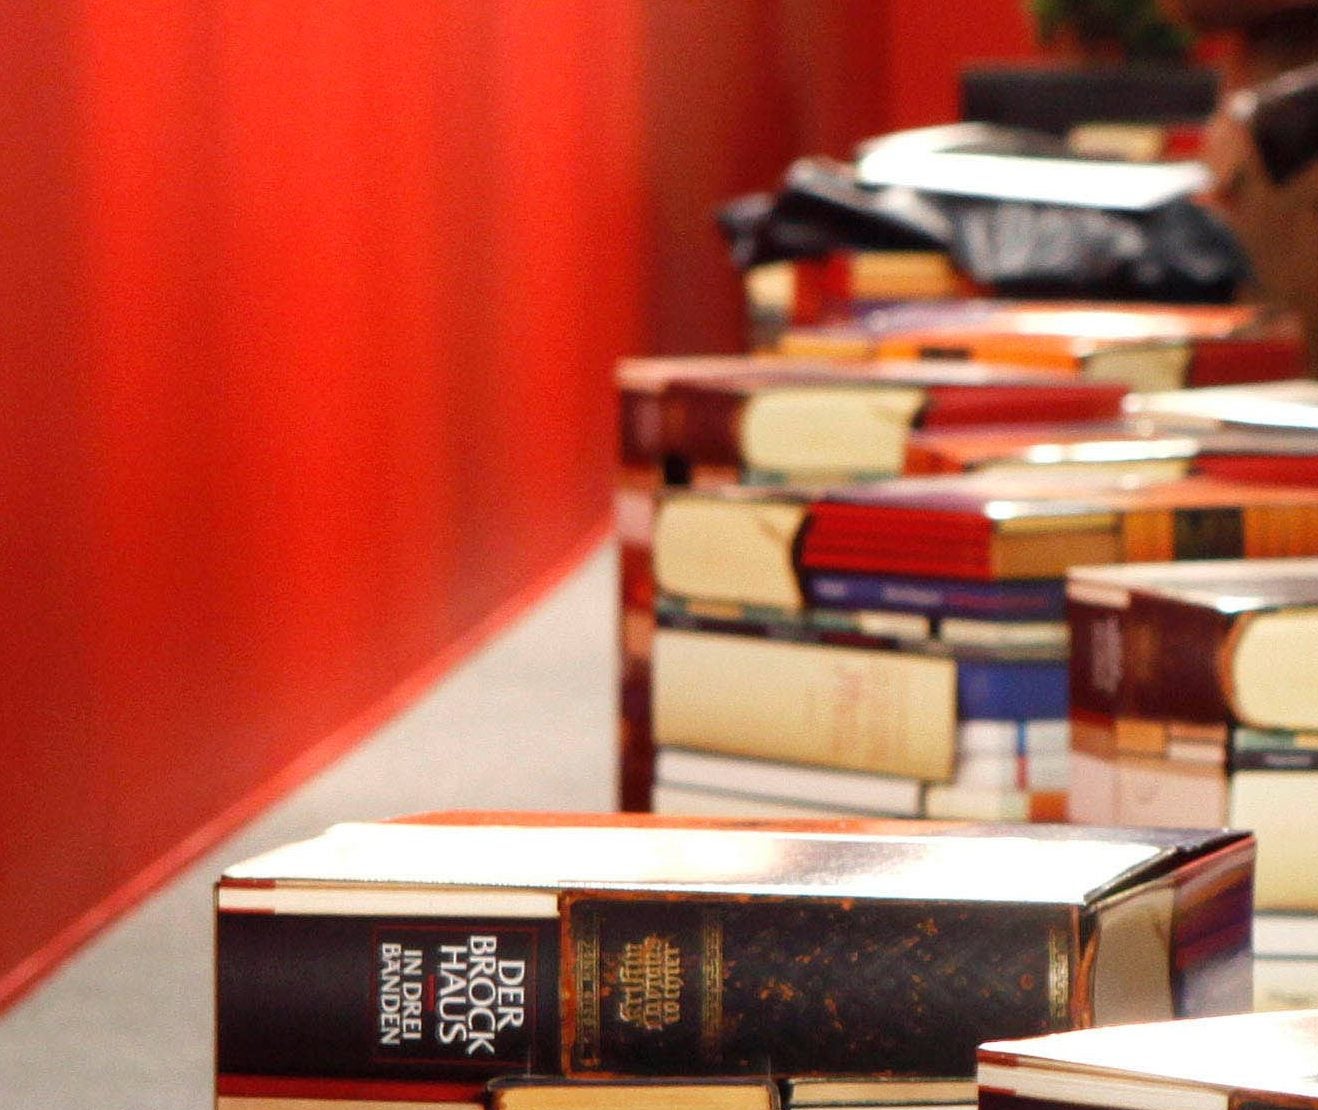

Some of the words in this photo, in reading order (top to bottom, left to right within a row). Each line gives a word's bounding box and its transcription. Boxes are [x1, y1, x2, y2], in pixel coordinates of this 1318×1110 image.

[403, 949, 422, 976] IN
[439, 945, 468, 1045] HAUS
[467, 935, 497, 1056] BROCK
[498, 960, 525, 1032] DER
[402, 981, 422, 1040] DREI
